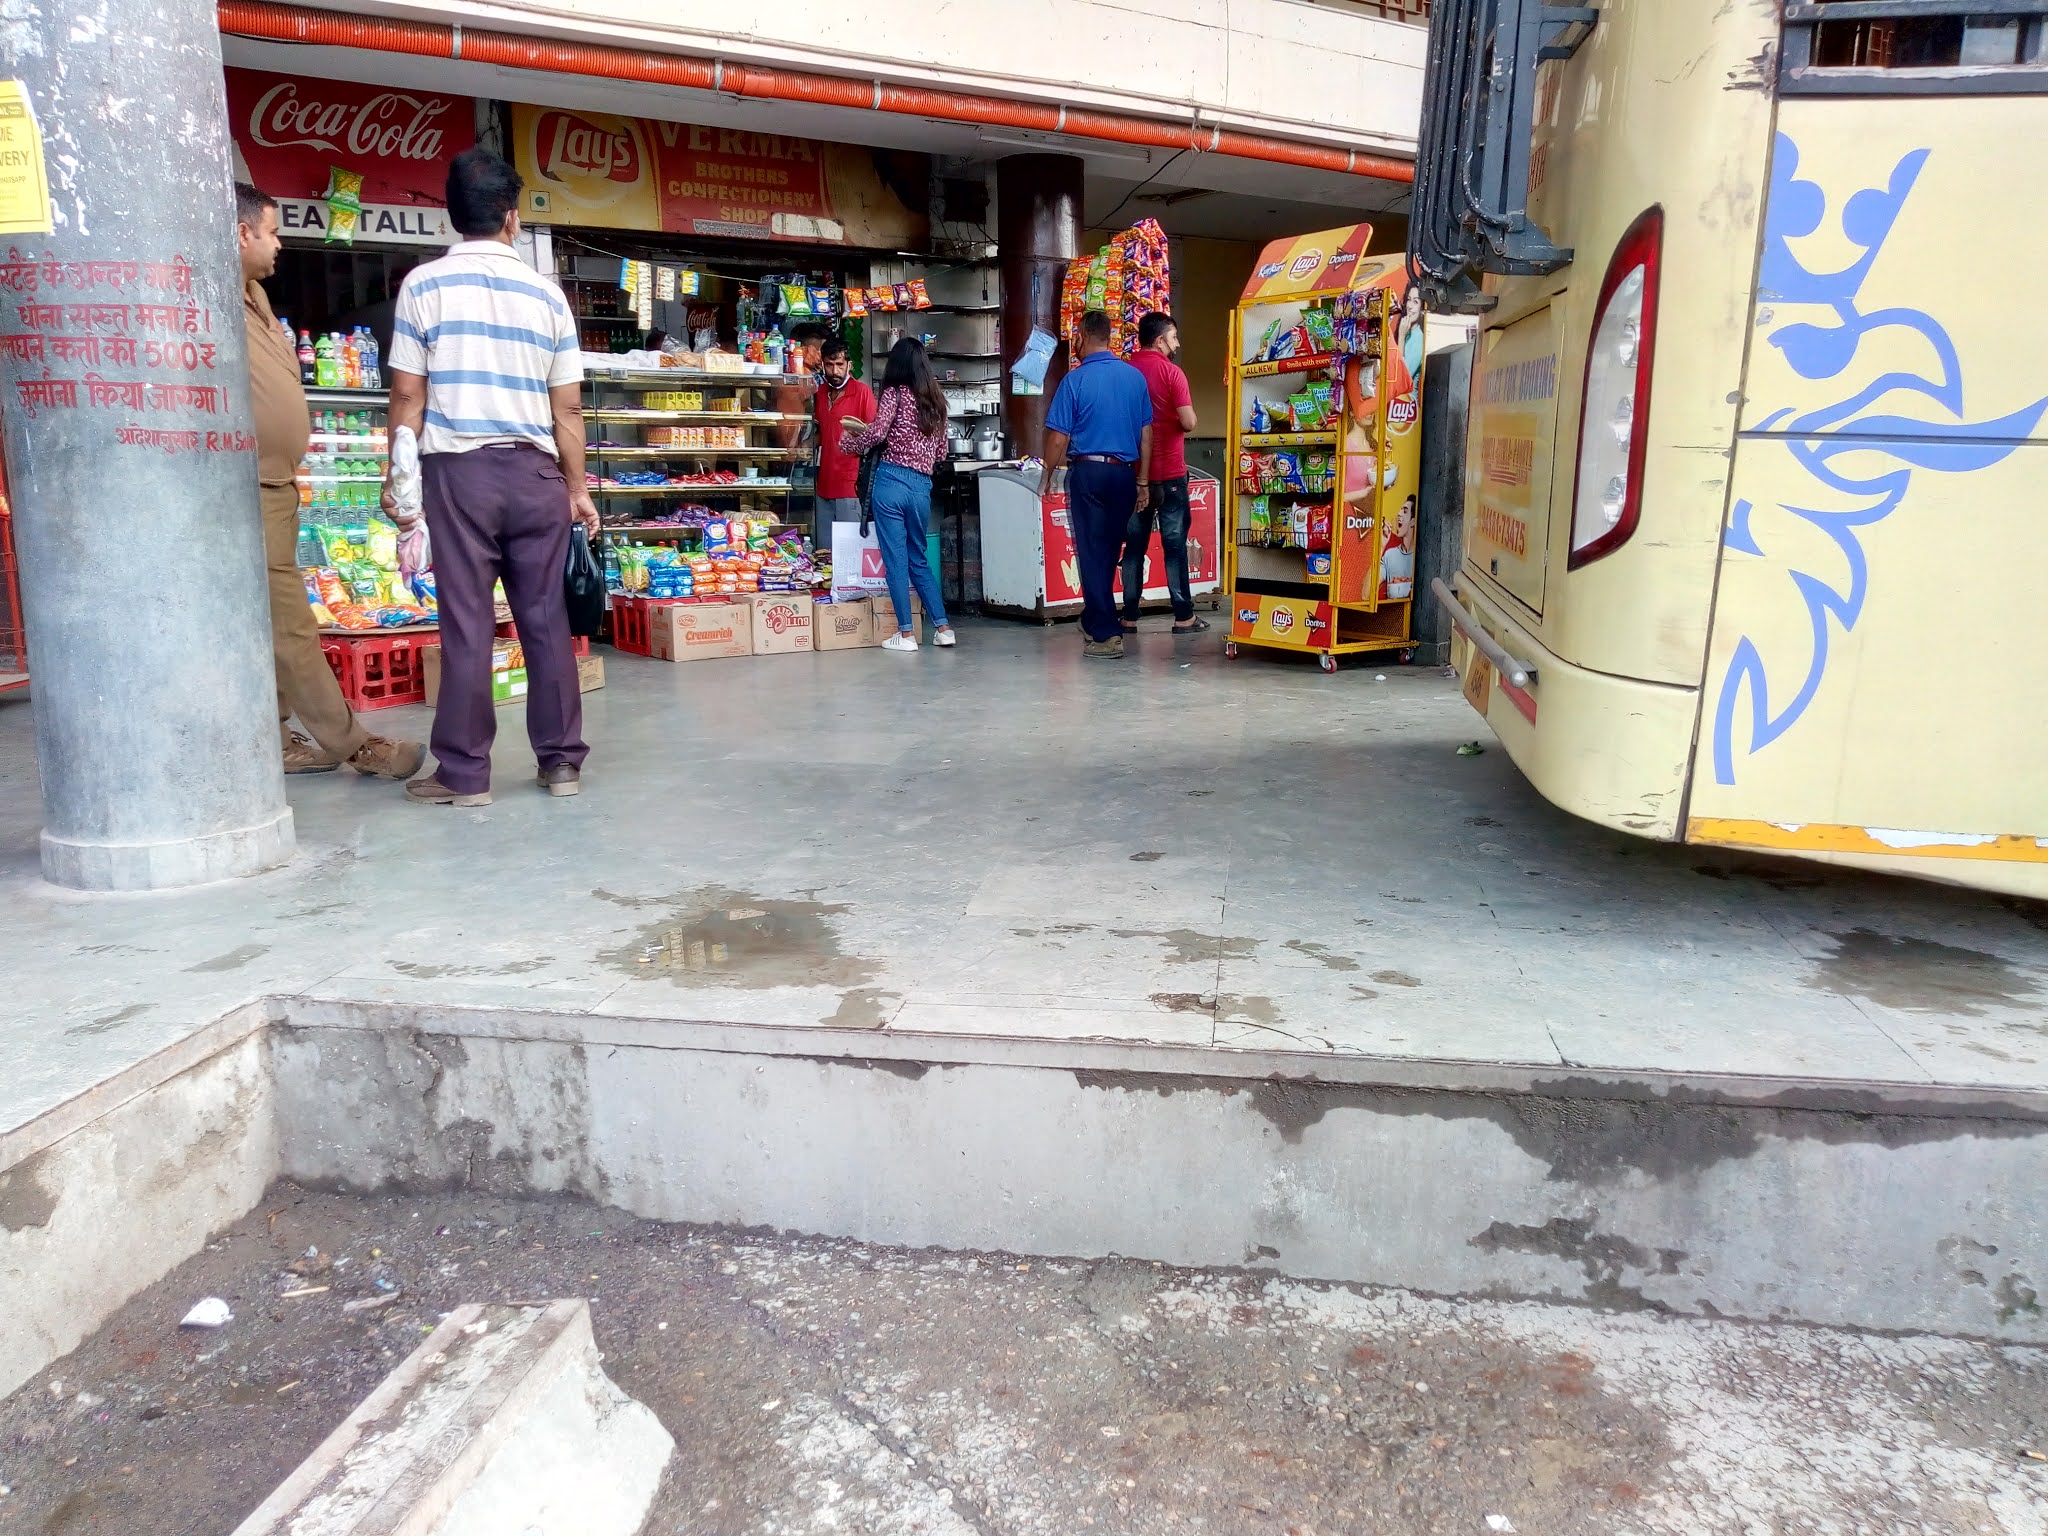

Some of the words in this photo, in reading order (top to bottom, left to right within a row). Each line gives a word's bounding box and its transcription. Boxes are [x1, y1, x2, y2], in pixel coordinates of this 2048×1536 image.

[250, 82, 452, 160] Coca-Cola
[695, 161, 789, 185] BROTHERS
[668, 180, 815, 208] CONFECTIONERY
[277, 203, 326, 230] EA
[359, 209, 435, 236] TALL
[720, 206, 768, 225] SHOP
[1259, 364, 1273, 373] NEW
[82, 371, 147, 412] किया
[1346, 516, 1375, 529] Dorit
[685, 626, 733, 641] Creamrich
